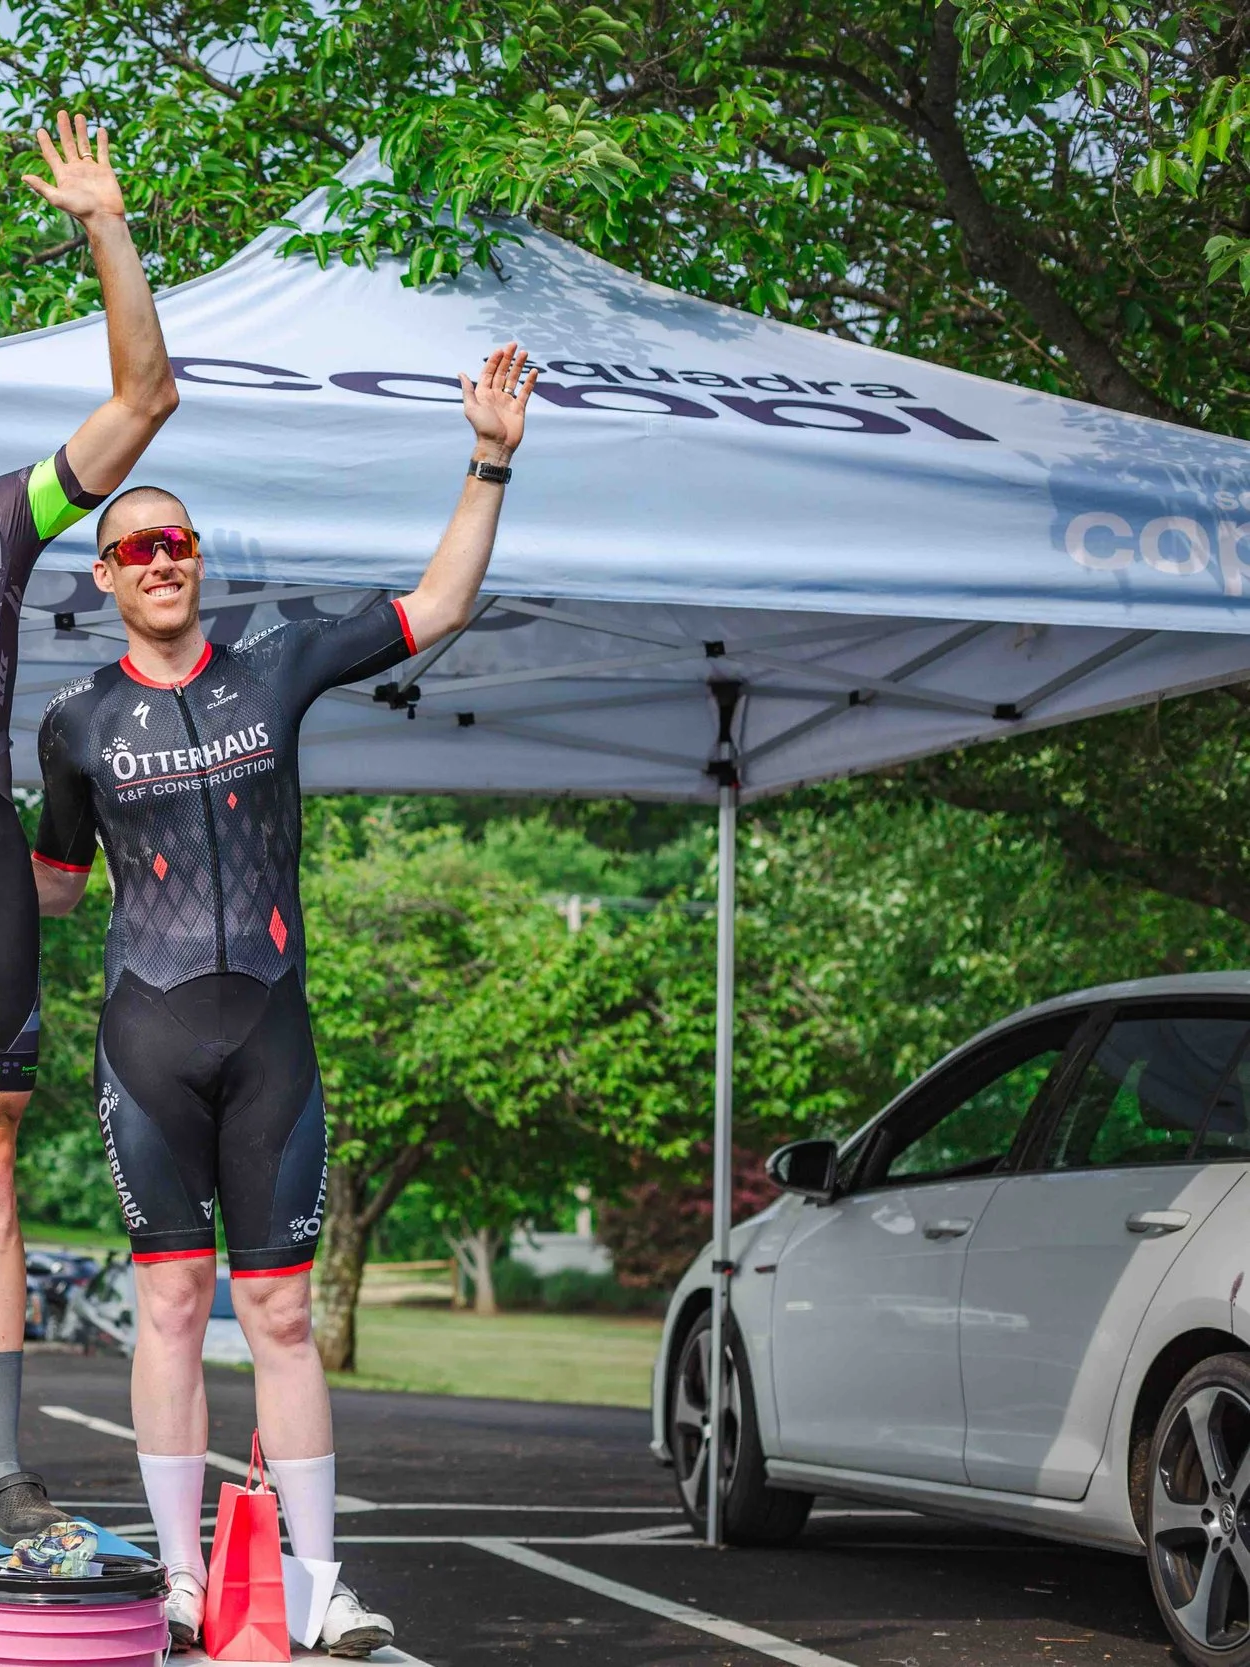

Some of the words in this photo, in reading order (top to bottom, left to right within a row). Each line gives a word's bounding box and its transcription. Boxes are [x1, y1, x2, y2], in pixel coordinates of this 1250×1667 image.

[207, 691, 239, 710] CUORE
[112, 722, 269, 780] OTTERHAUS
[117, 787, 147, 804] K&F
[152, 757, 275, 796] CONSTRUCTION
[98, 1097, 148, 1230] OTTERHAUS
